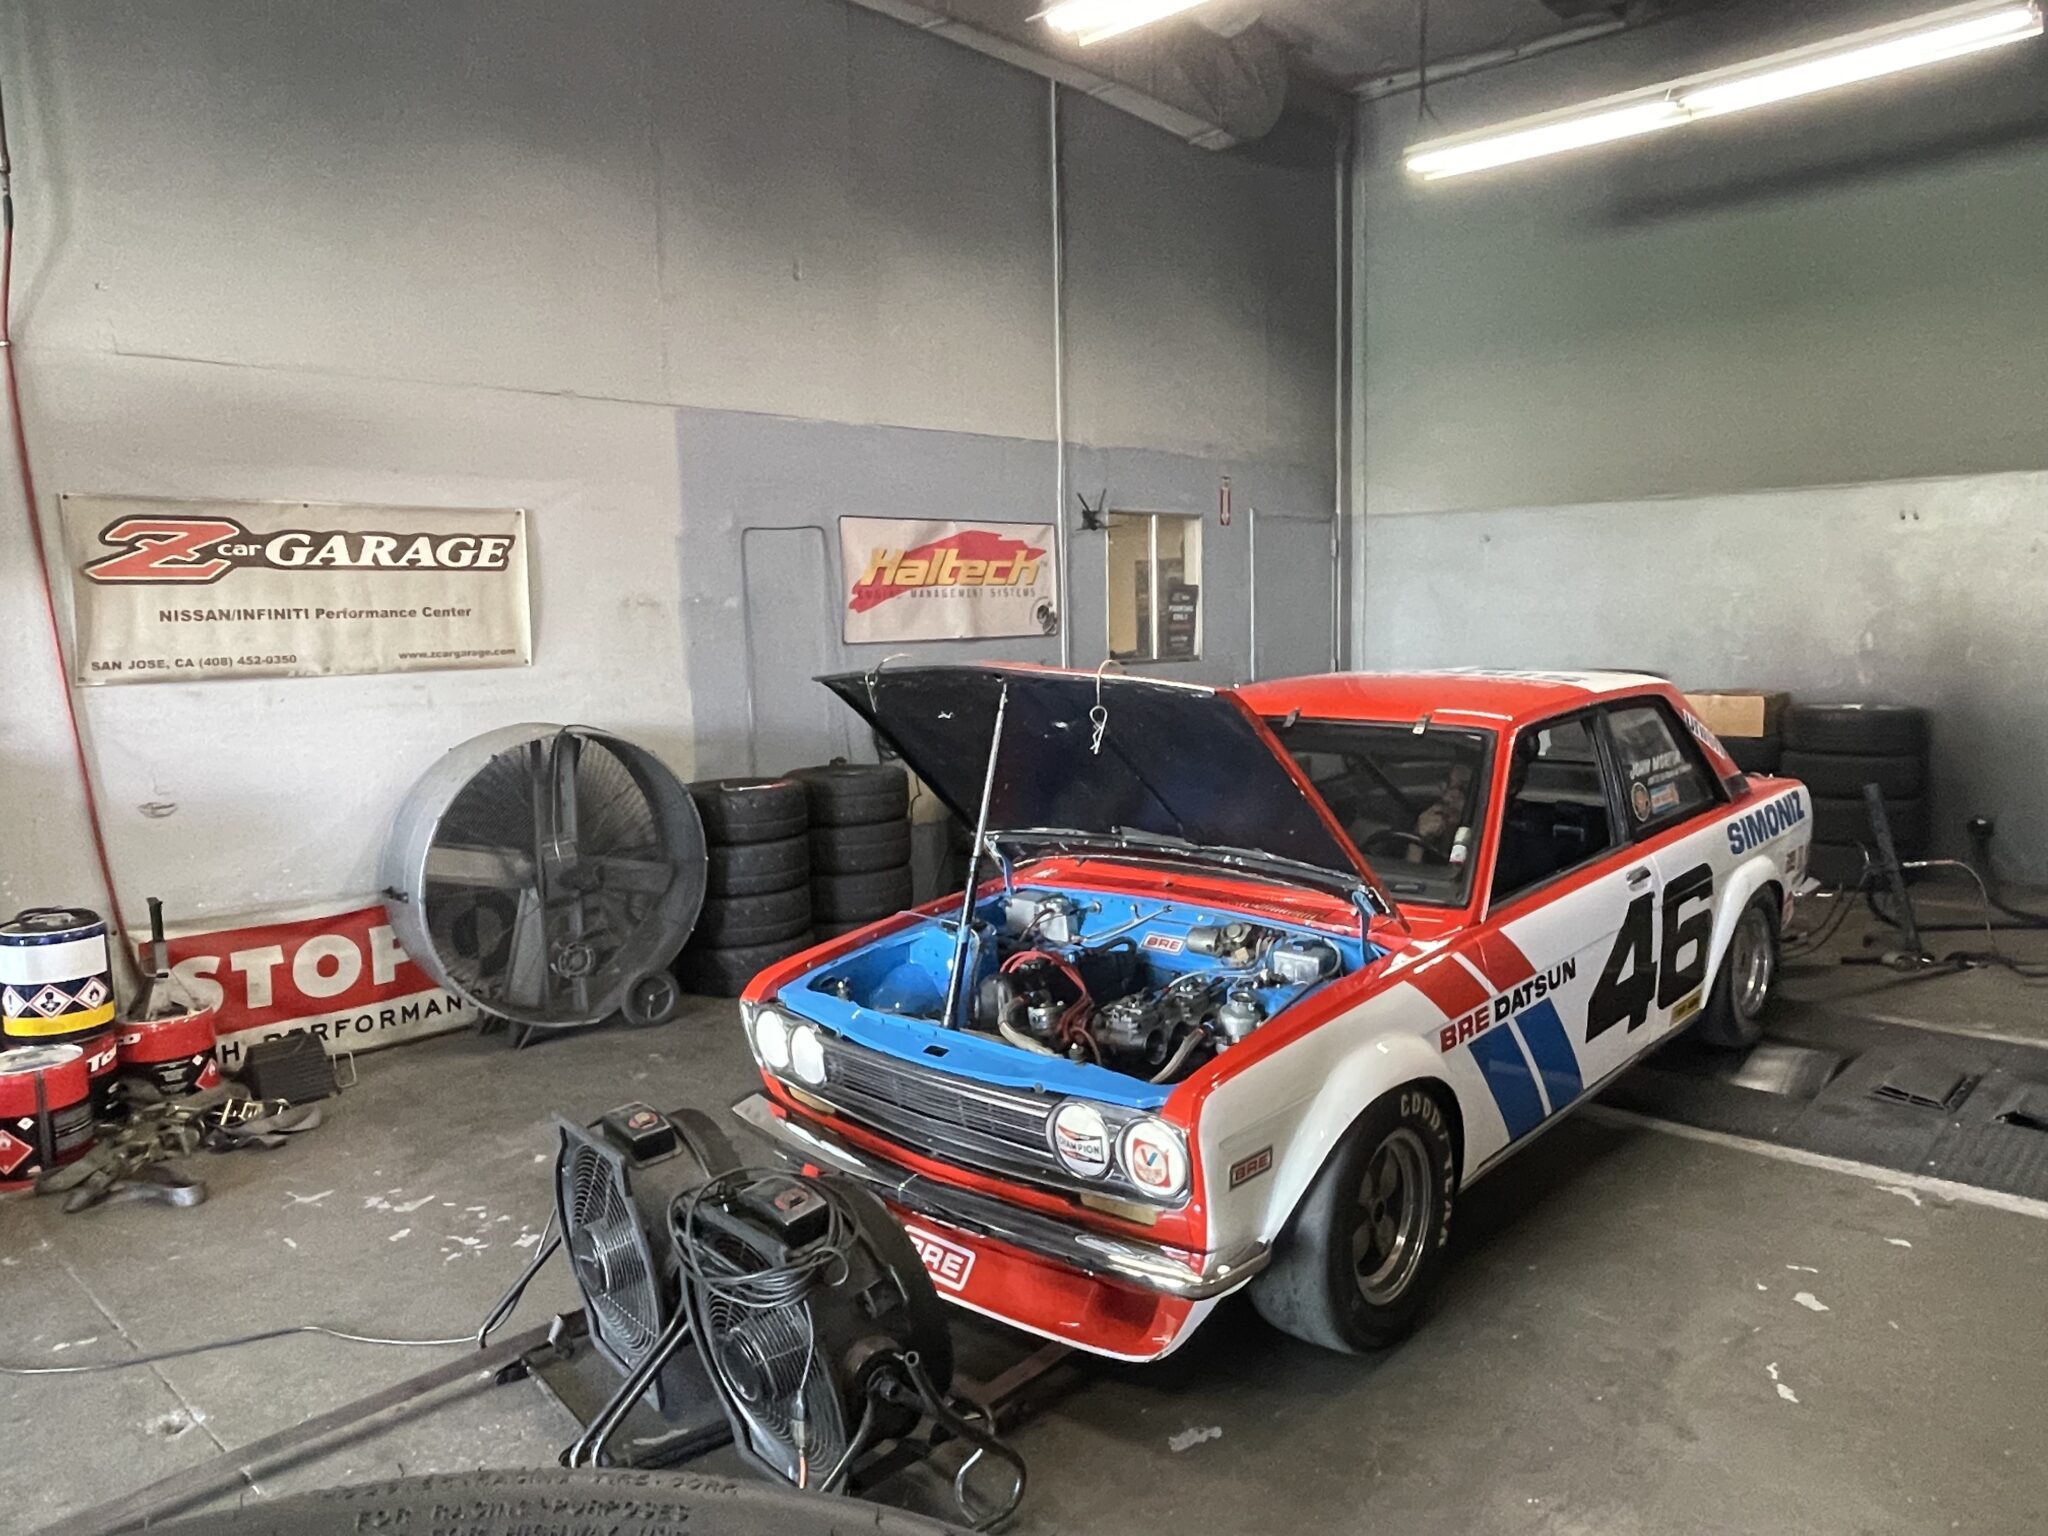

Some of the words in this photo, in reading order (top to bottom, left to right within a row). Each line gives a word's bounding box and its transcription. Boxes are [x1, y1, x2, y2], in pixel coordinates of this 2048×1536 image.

[84, 519, 240, 580] Z
[218, 544, 262, 556] car
[264, 533, 515, 568] GARAGE
[859, 548, 1040, 586] Haltech
[990, 586, 1036, 598] SYSTEMS
[159, 608, 309, 622] NISSAN/INFINITI
[315, 607, 417, 620] Performance
[422, 606, 472, 618] Center
[91, 661, 123, 671] SAN
[128, 659, 170, 670] JOSE,
[175, 658, 195, 668] CA
[199, 657, 233, 668] (408)
[237, 655, 297, 666] 452-0350
[398, 648, 516, 660] www.zcargarage.com
[1727, 790, 1805, 855] SIMONIZ
[1146, 937, 1180, 950] BRE
[1585, 863, 1714, 1044] 46
[1440, 1005, 1490, 1053] BRE
[1494, 957, 1576, 1022] DATSUN
[1060, 1136, 1100, 1154] CHAMPION
[1235, 1153, 1268, 1181] BRE
